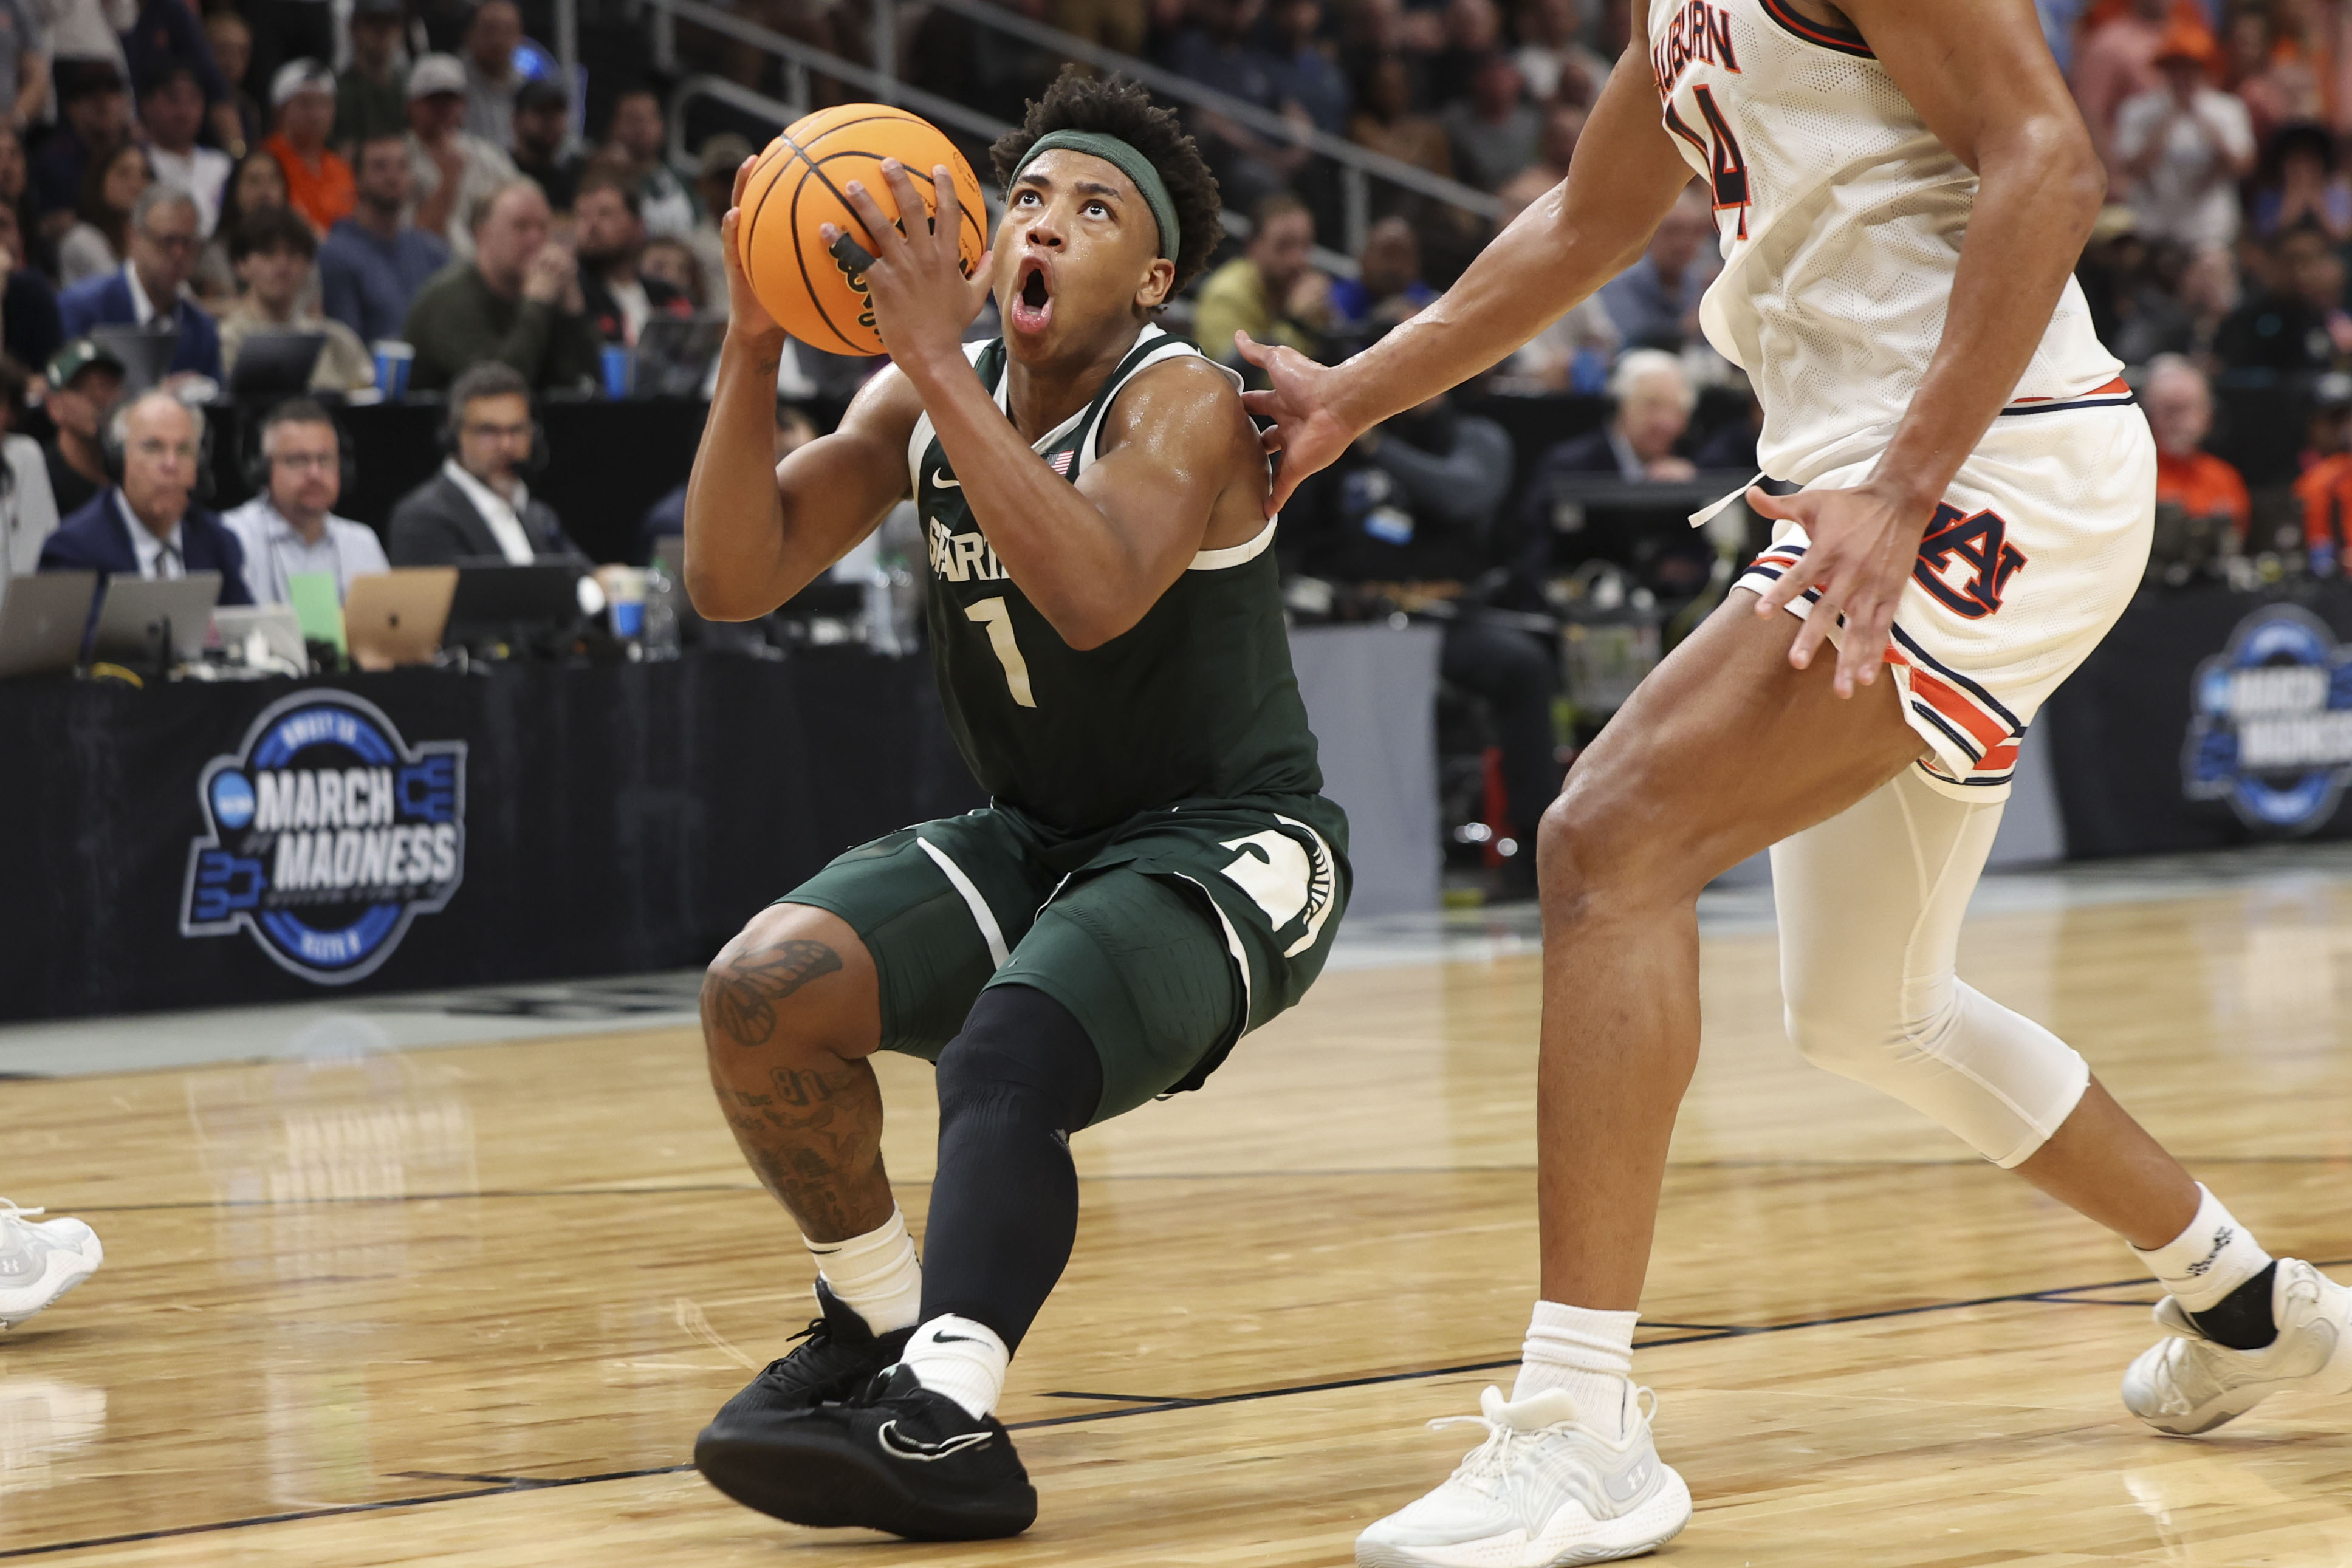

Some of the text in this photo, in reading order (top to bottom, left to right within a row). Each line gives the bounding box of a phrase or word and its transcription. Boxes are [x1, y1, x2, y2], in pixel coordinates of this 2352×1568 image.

[929, 515, 1011, 582] SPART
[255, 766, 395, 832] MARCH
[273, 823, 457, 891] MADNESS
